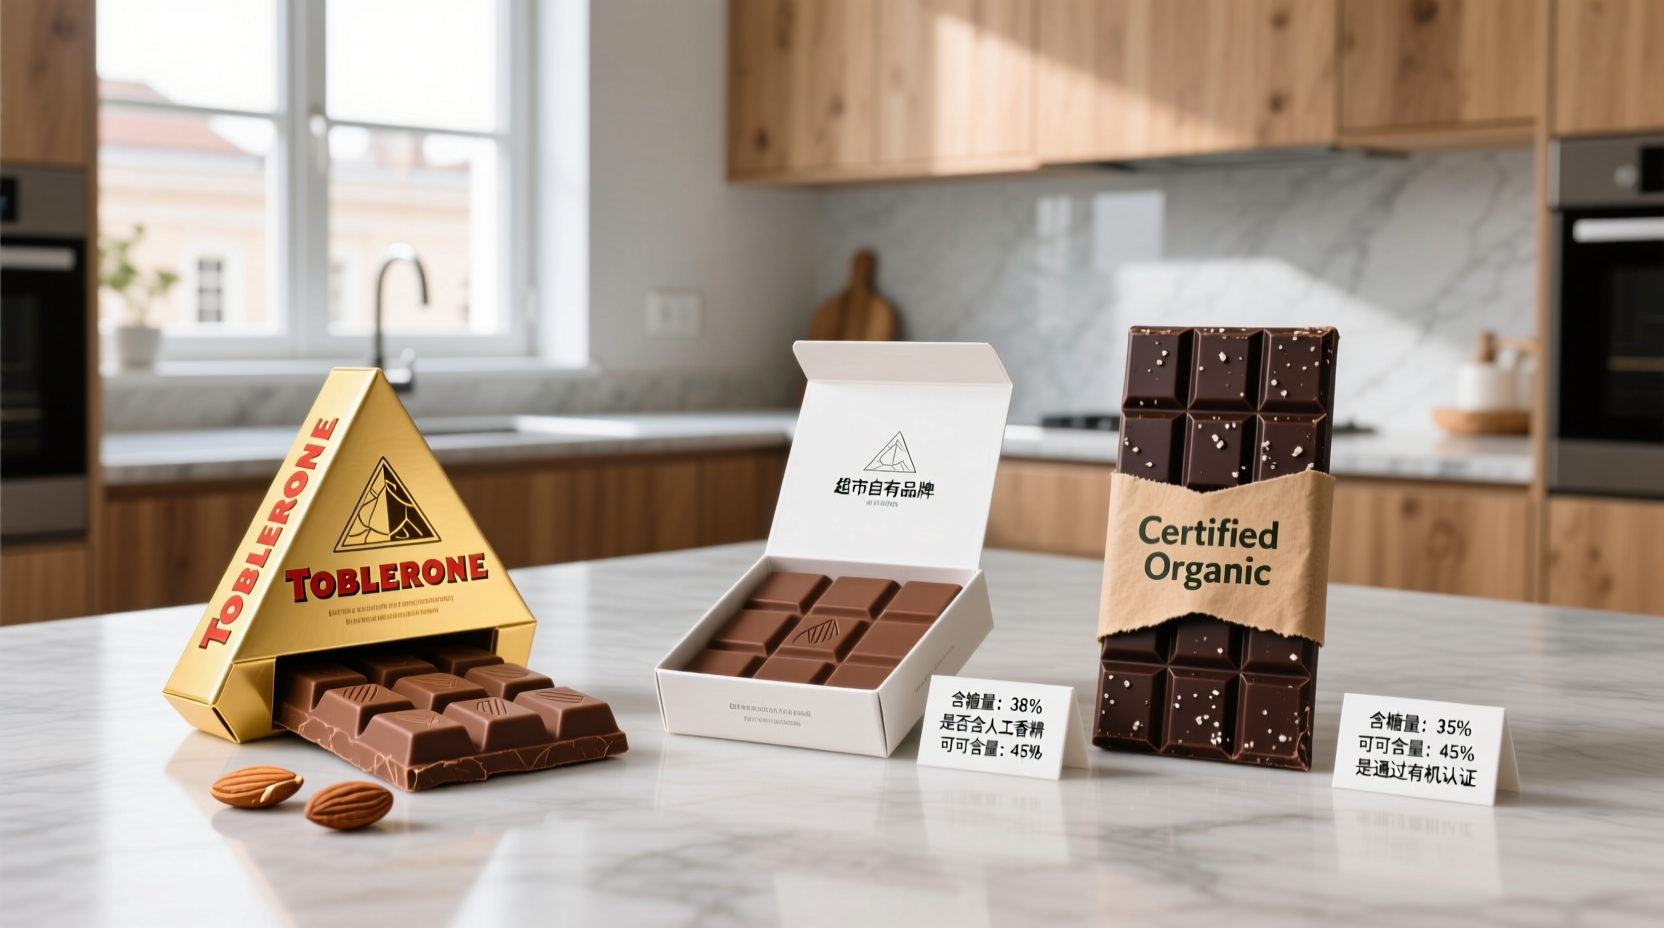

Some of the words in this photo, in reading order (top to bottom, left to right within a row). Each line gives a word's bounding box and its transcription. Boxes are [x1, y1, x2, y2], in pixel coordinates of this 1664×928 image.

[199, 417, 339, 650] TOBLERONE
[1138, 515, 1279, 549] Certified
[285, 552, 488, 603] TOBLERONE
[1144, 552, 1272, 590] Organic
[1355, 758, 1477, 787] 是通过有机认证
